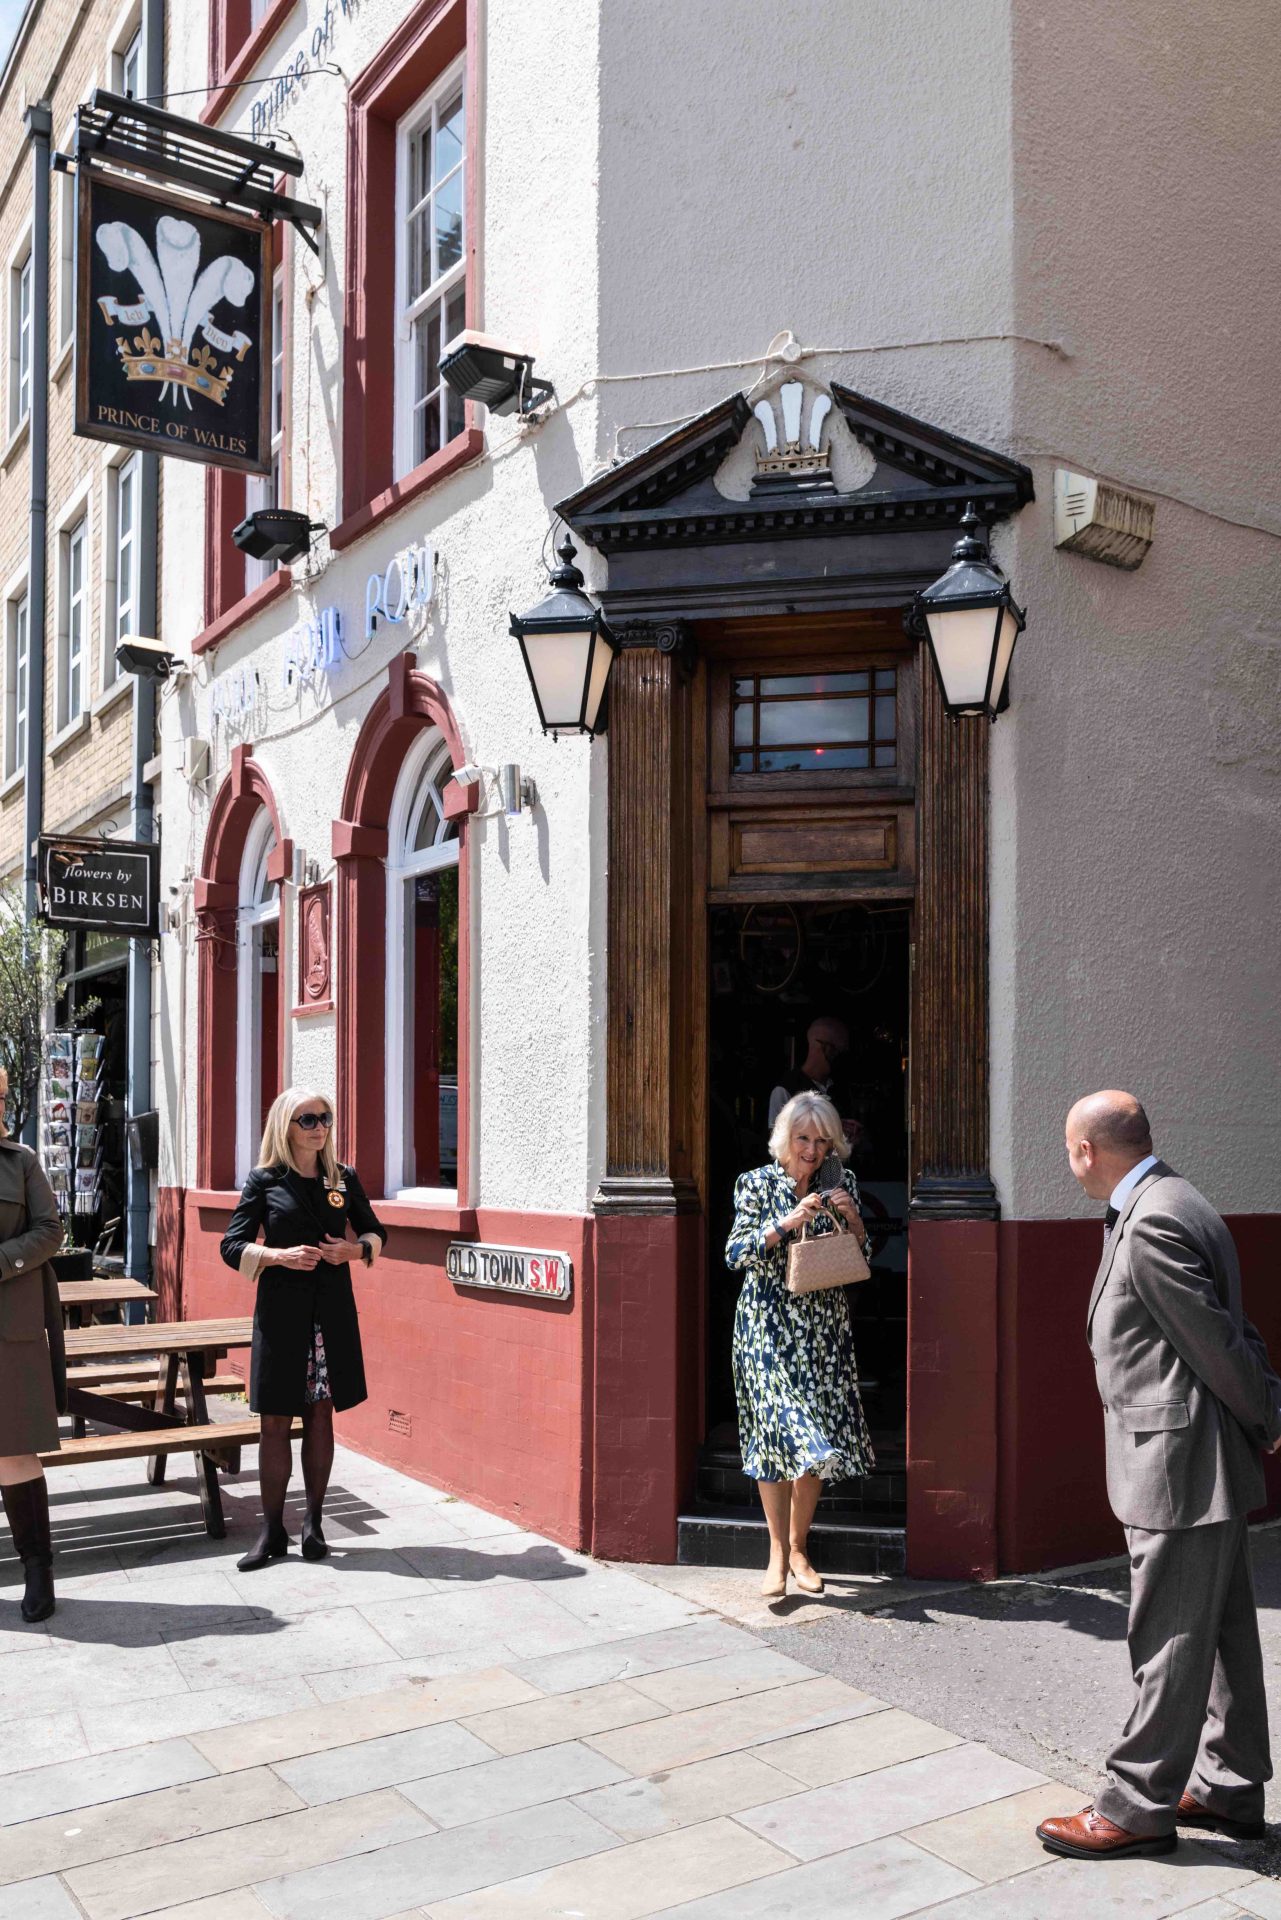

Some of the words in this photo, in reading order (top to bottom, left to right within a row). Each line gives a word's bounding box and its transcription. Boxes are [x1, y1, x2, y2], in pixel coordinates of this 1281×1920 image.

[98, 405, 160, 433] PRINCE
[166, 422, 189, 441] OF
[194, 427, 247, 455] WALES
[62, 865, 113, 880] flowers
[116, 869, 132, 884] by
[53, 886, 144, 909] BIRKSEN
[448, 1248, 477, 1279] OLD
